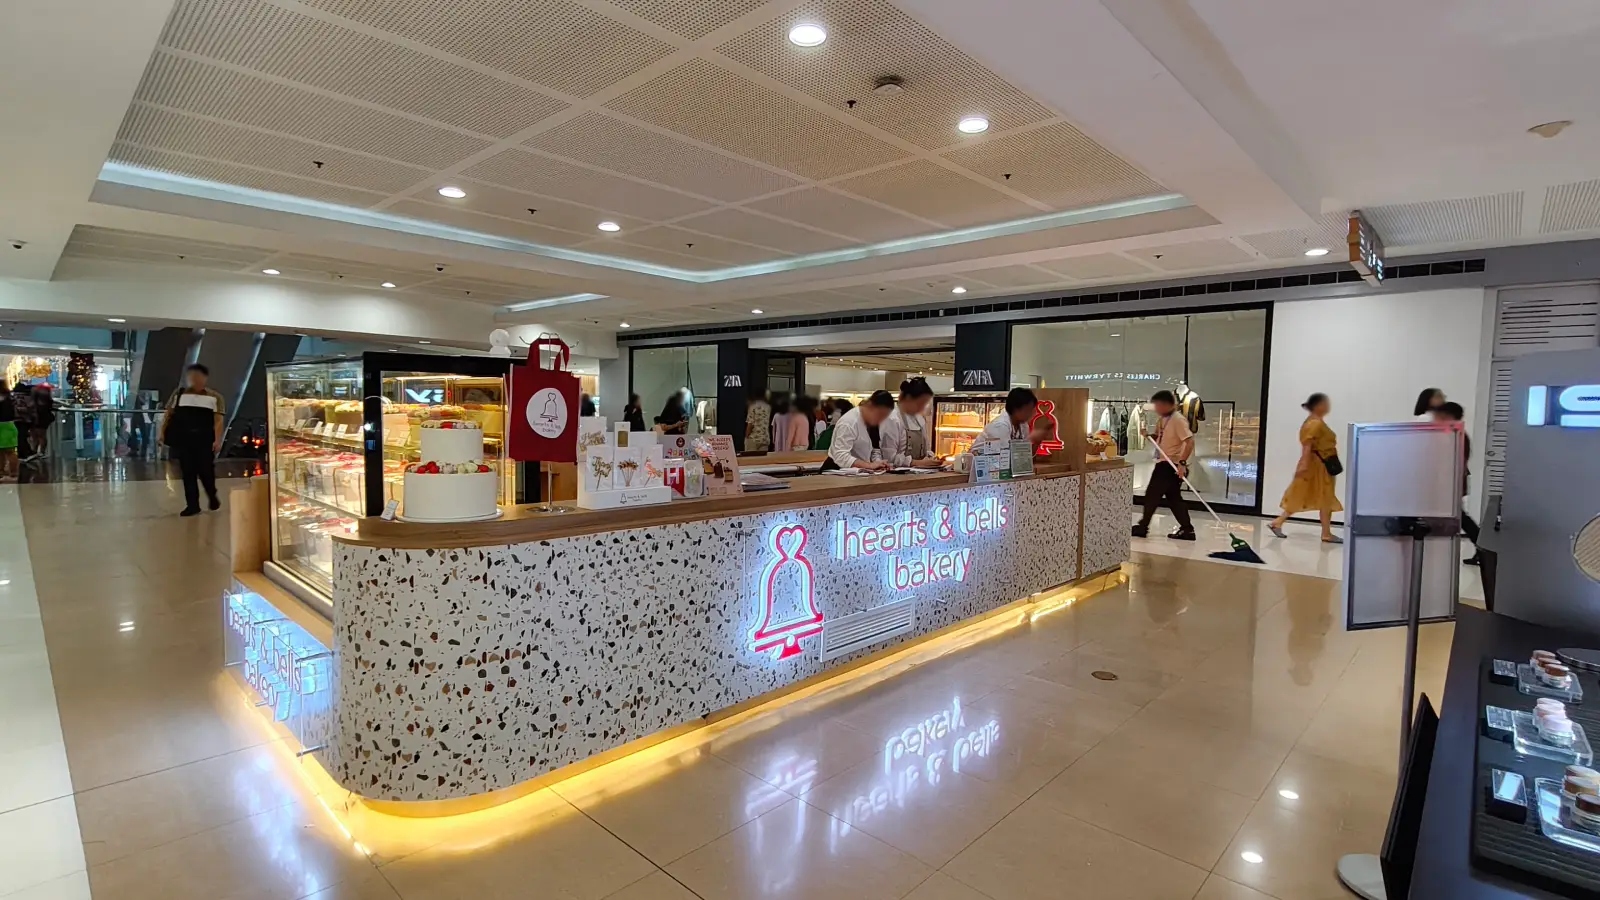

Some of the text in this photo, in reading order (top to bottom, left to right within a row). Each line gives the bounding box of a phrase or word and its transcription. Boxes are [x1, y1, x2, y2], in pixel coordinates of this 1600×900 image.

[963, 369, 994, 386] ZARA
[836, 497, 1009, 560] hearts & bells
[888, 548, 972, 590] bakery
